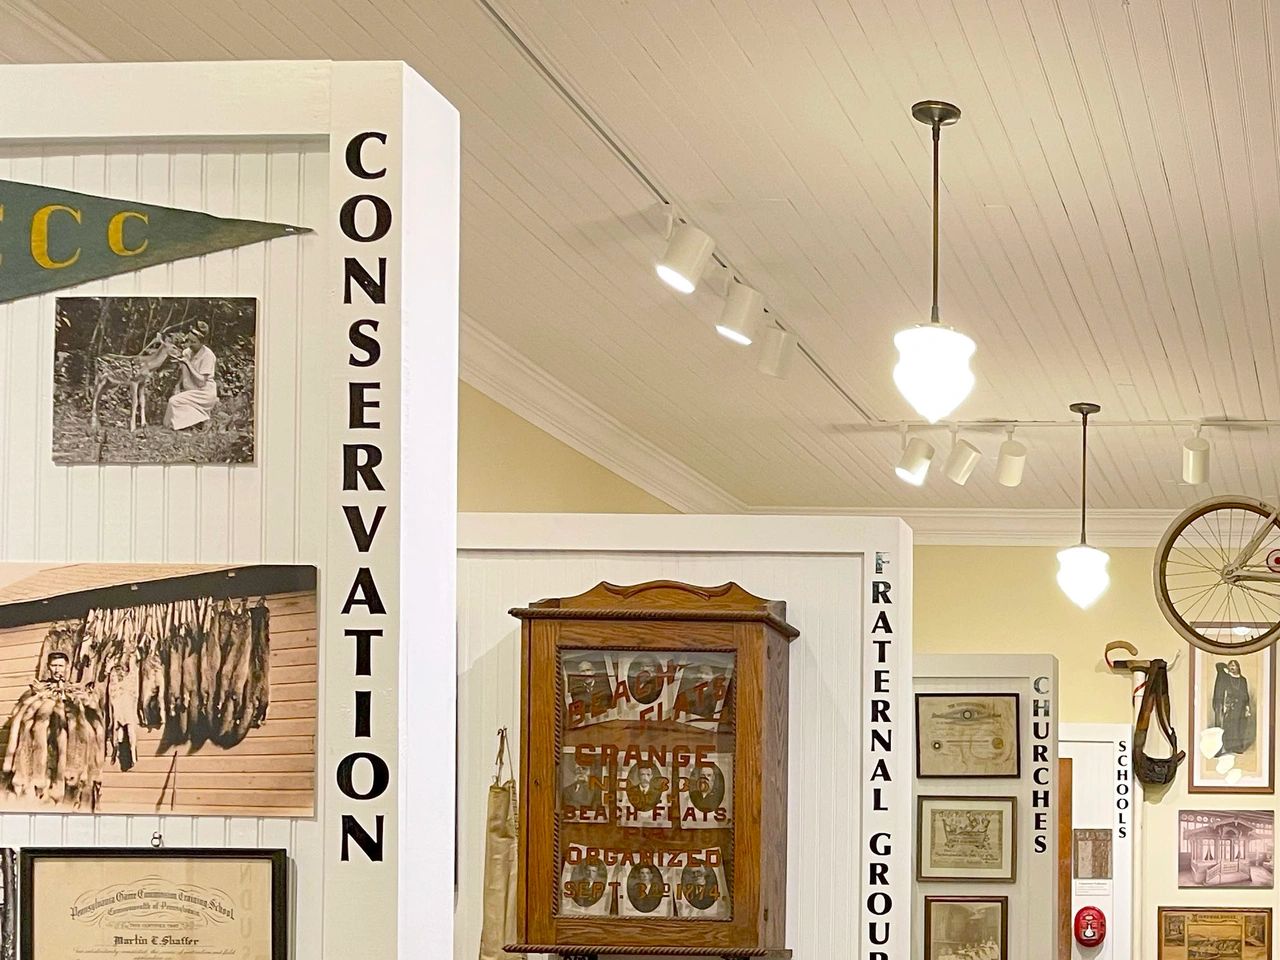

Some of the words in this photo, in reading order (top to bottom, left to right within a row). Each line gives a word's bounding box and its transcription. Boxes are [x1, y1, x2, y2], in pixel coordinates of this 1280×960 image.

[0, 204, 148, 269] CC
[337, 132, 391, 862] CONSERVATION
[567, 659, 680, 728] BEACH
[870, 552, 893, 811] FRATERNAL
[574, 743, 716, 768] GRANGE
[1033, 677, 1049, 853] CHURCHES
[564, 805, 638, 821] BEACH
[1117, 741, 1129, 839] SCHOOLS
[565, 847, 721, 868] ORGANIZED
[113, 934, 148, 945] Martin
